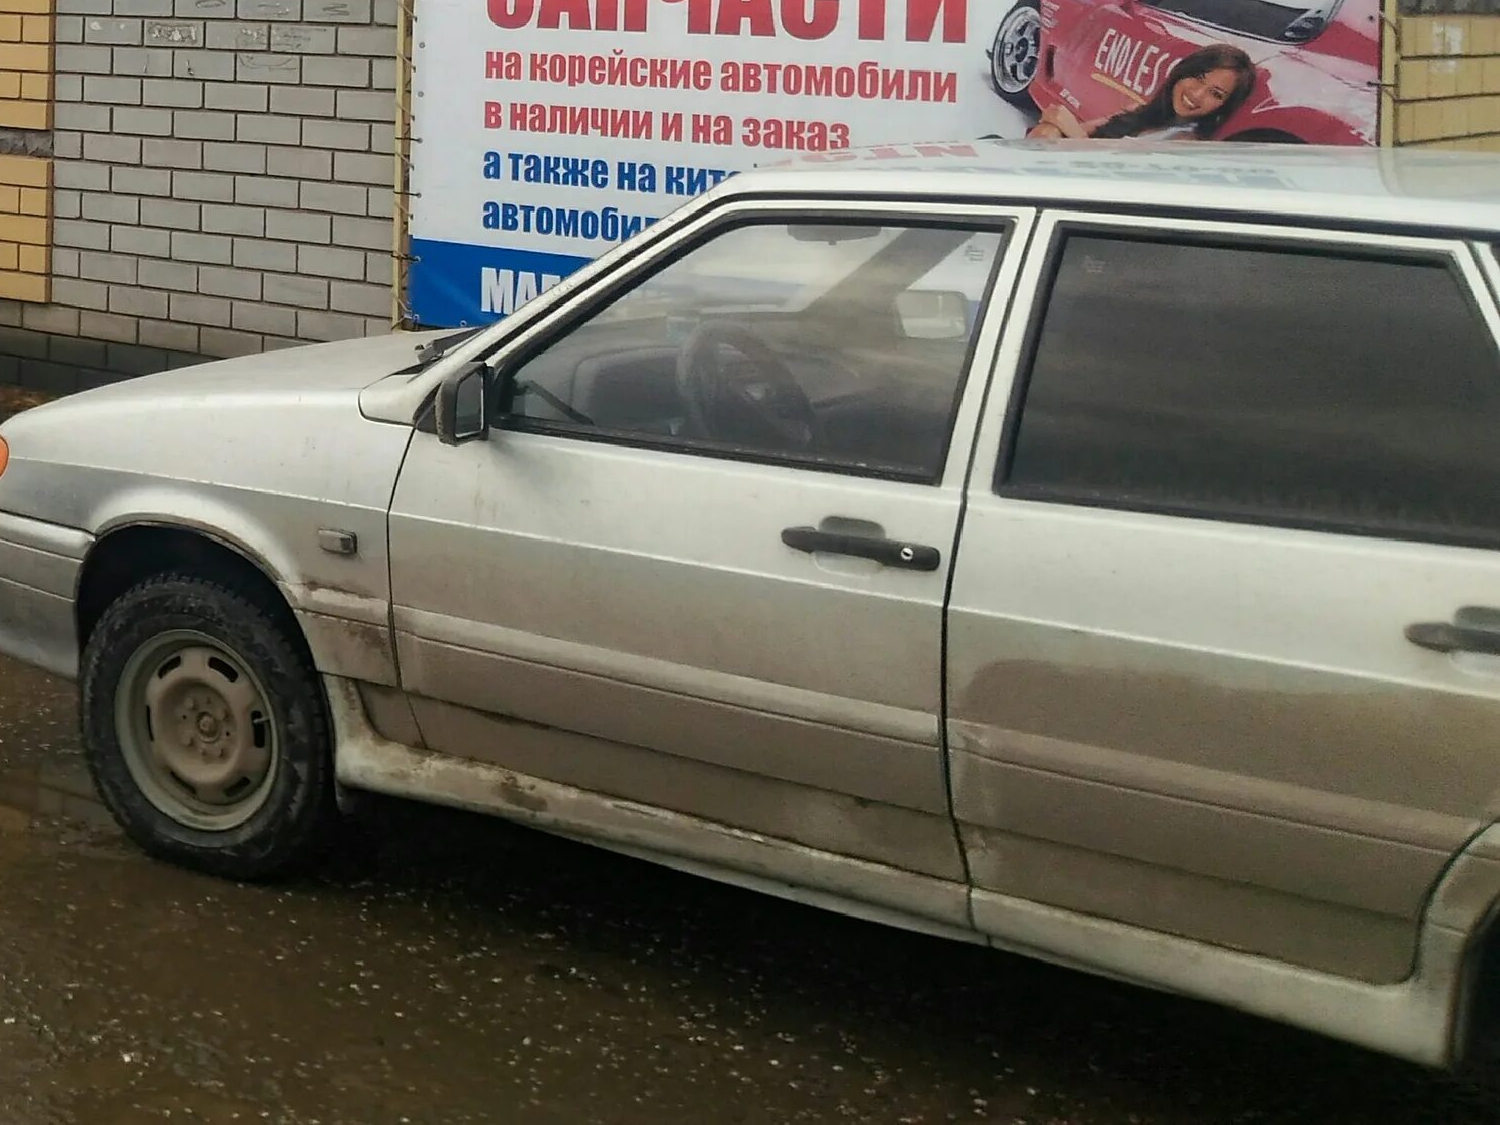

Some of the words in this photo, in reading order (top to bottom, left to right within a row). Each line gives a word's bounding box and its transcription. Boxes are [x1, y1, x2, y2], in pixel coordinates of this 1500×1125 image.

[484, 50, 522, 81] на
[529, 49, 712, 91] корейские
[720, 61, 958, 104] автомобили
[484, 101, 502, 130] в
[509, 101, 653, 141] наличии
[661, 112, 683, 142] и
[691, 112, 732, 146] на
[742, 116, 851, 152] заказ
[483, 151, 501, 180] а
[507, 152, 609, 189] также
[617, 161, 657, 193] на
[665, 165, 742, 196] кит
